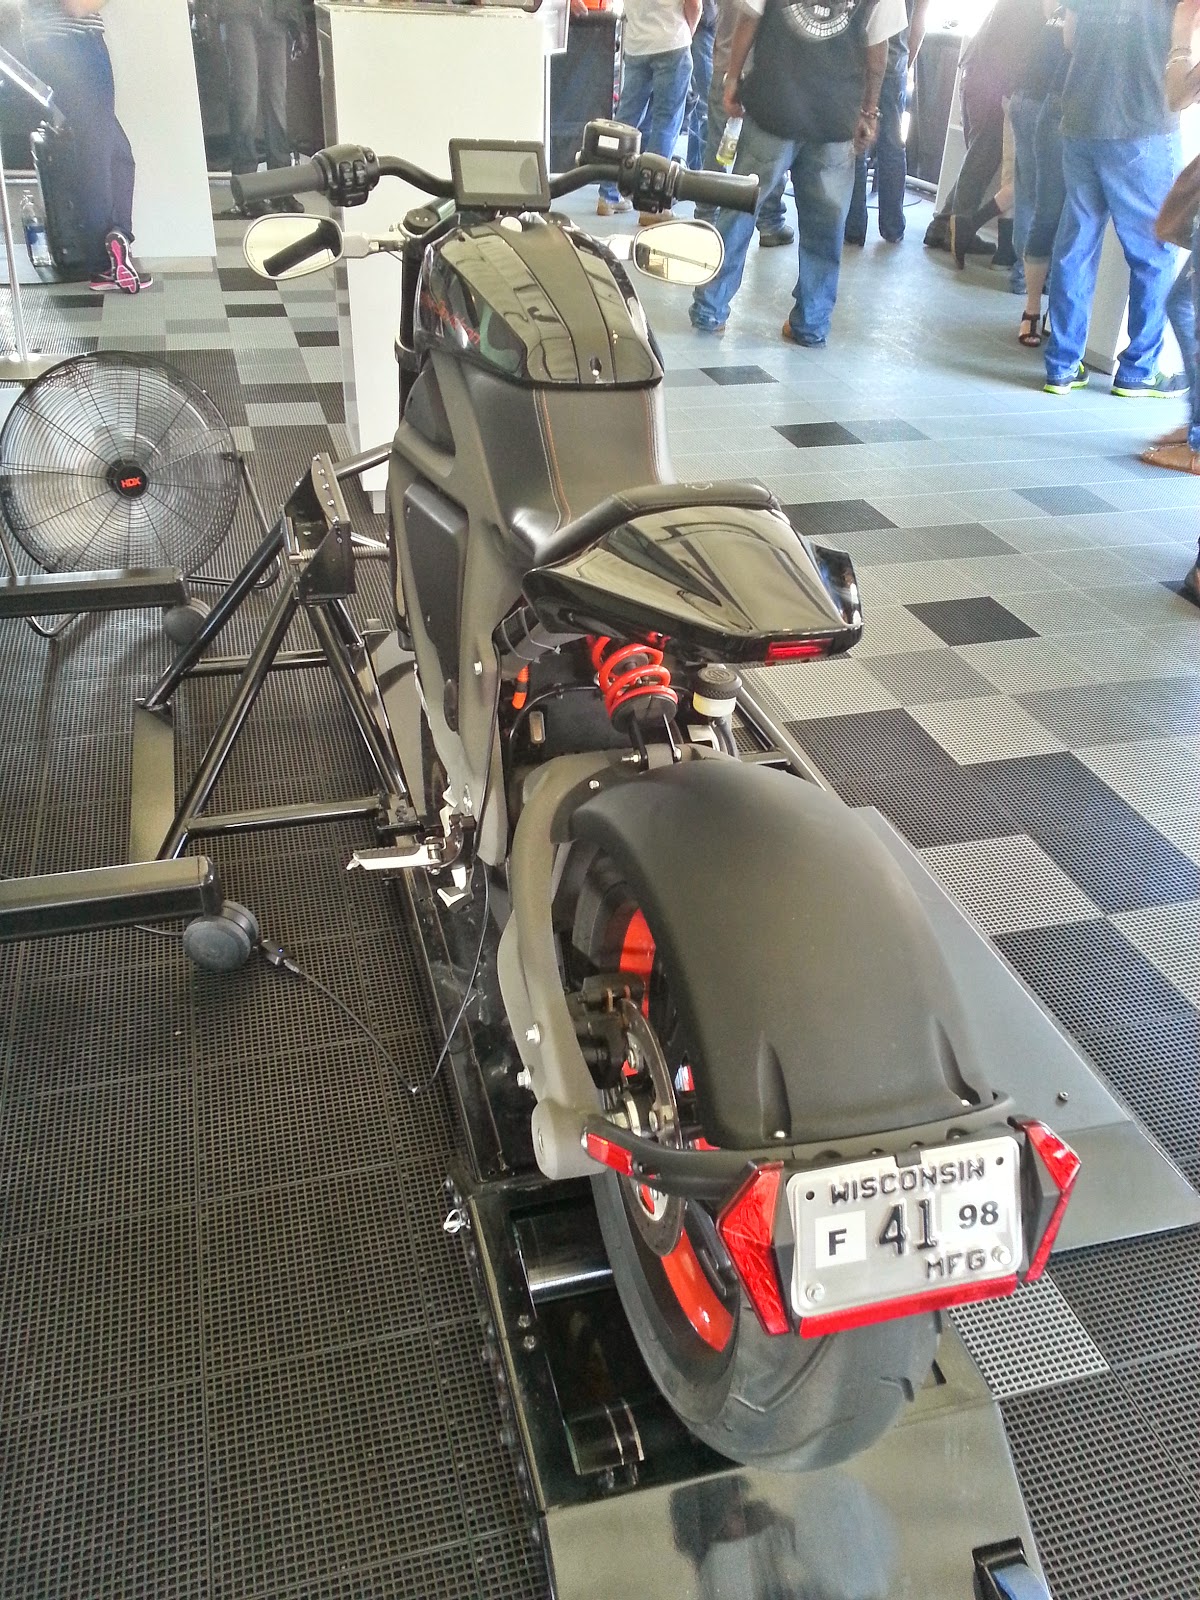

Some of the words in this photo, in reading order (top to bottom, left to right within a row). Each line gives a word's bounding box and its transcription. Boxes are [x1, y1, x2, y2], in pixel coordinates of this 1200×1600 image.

[121, 476, 142, 488] HDX
[830, 1157, 985, 1204] WISCONSIN
[828, 1228, 847, 1256] F
[878, 1198, 938, 1255] 41
[958, 1200, 1000, 1230] 98
[923, 1248, 988, 1279] MFG
